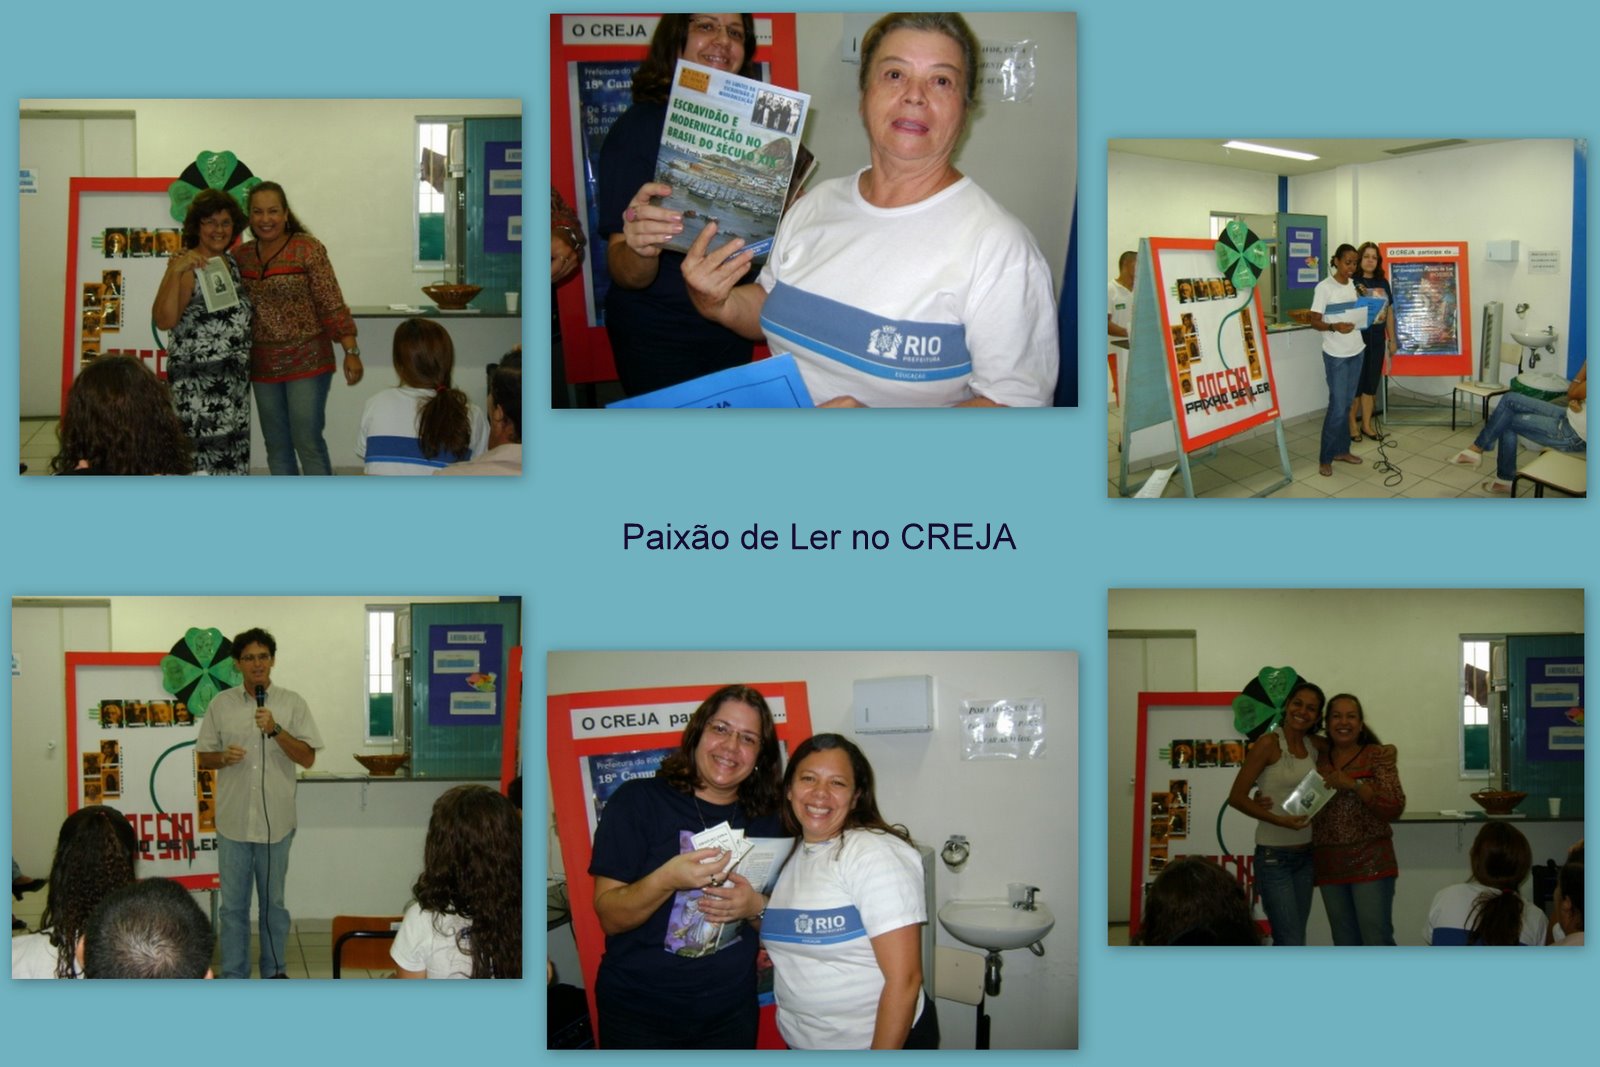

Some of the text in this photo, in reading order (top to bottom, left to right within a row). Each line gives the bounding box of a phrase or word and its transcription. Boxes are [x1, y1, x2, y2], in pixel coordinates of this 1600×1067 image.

[572, 23, 647, 37] O CREJA
[673, 98, 739, 127] ESCRAVIDÃO E
[670, 112, 762, 149] MODERNIZAÇÃO NO
[667, 126, 696, 145] BRASIL
[698, 137, 714, 150] DO
[716, 141, 755, 162] SÉCULO
[756, 154, 778, 169] XIX
[903, 335, 942, 356] RIO
[1250, 382, 1271, 396] LER
[581, 716, 596, 731] O
[600, 712, 660, 729] CREJA
[815, 915, 846, 930] RIO
